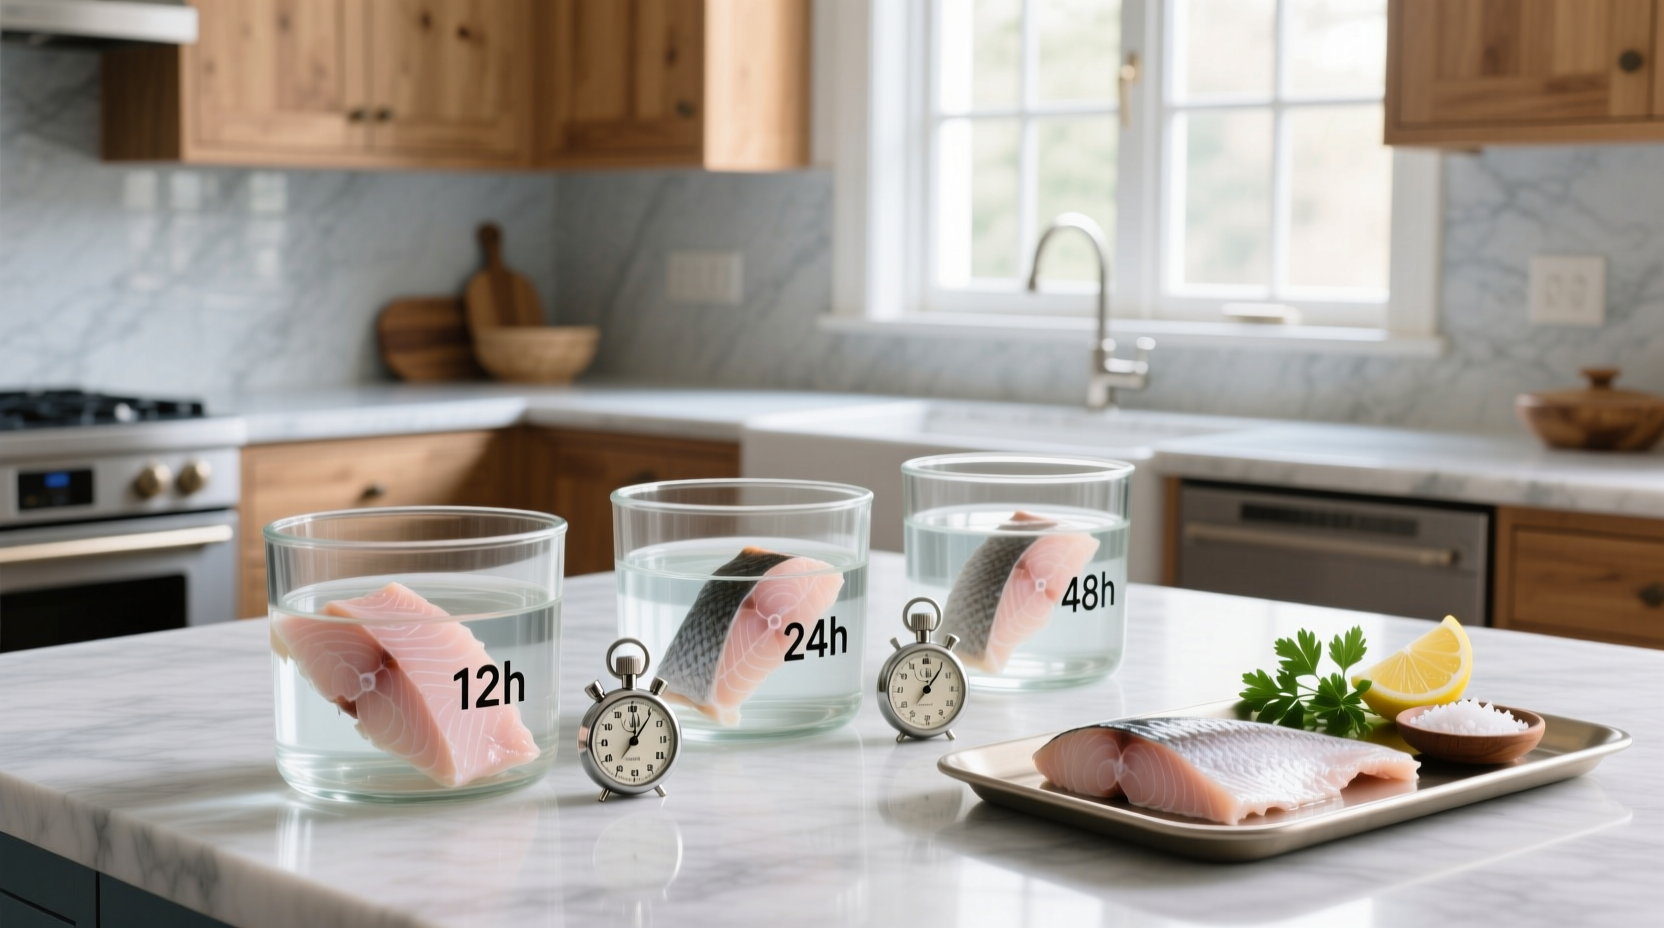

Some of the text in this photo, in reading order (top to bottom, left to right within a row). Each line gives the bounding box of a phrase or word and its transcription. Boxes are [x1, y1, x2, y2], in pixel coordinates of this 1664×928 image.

[1061, 571, 1116, 613] 48h
[783, 615, 848, 662] 24h
[453, 660, 525, 711] 12h
